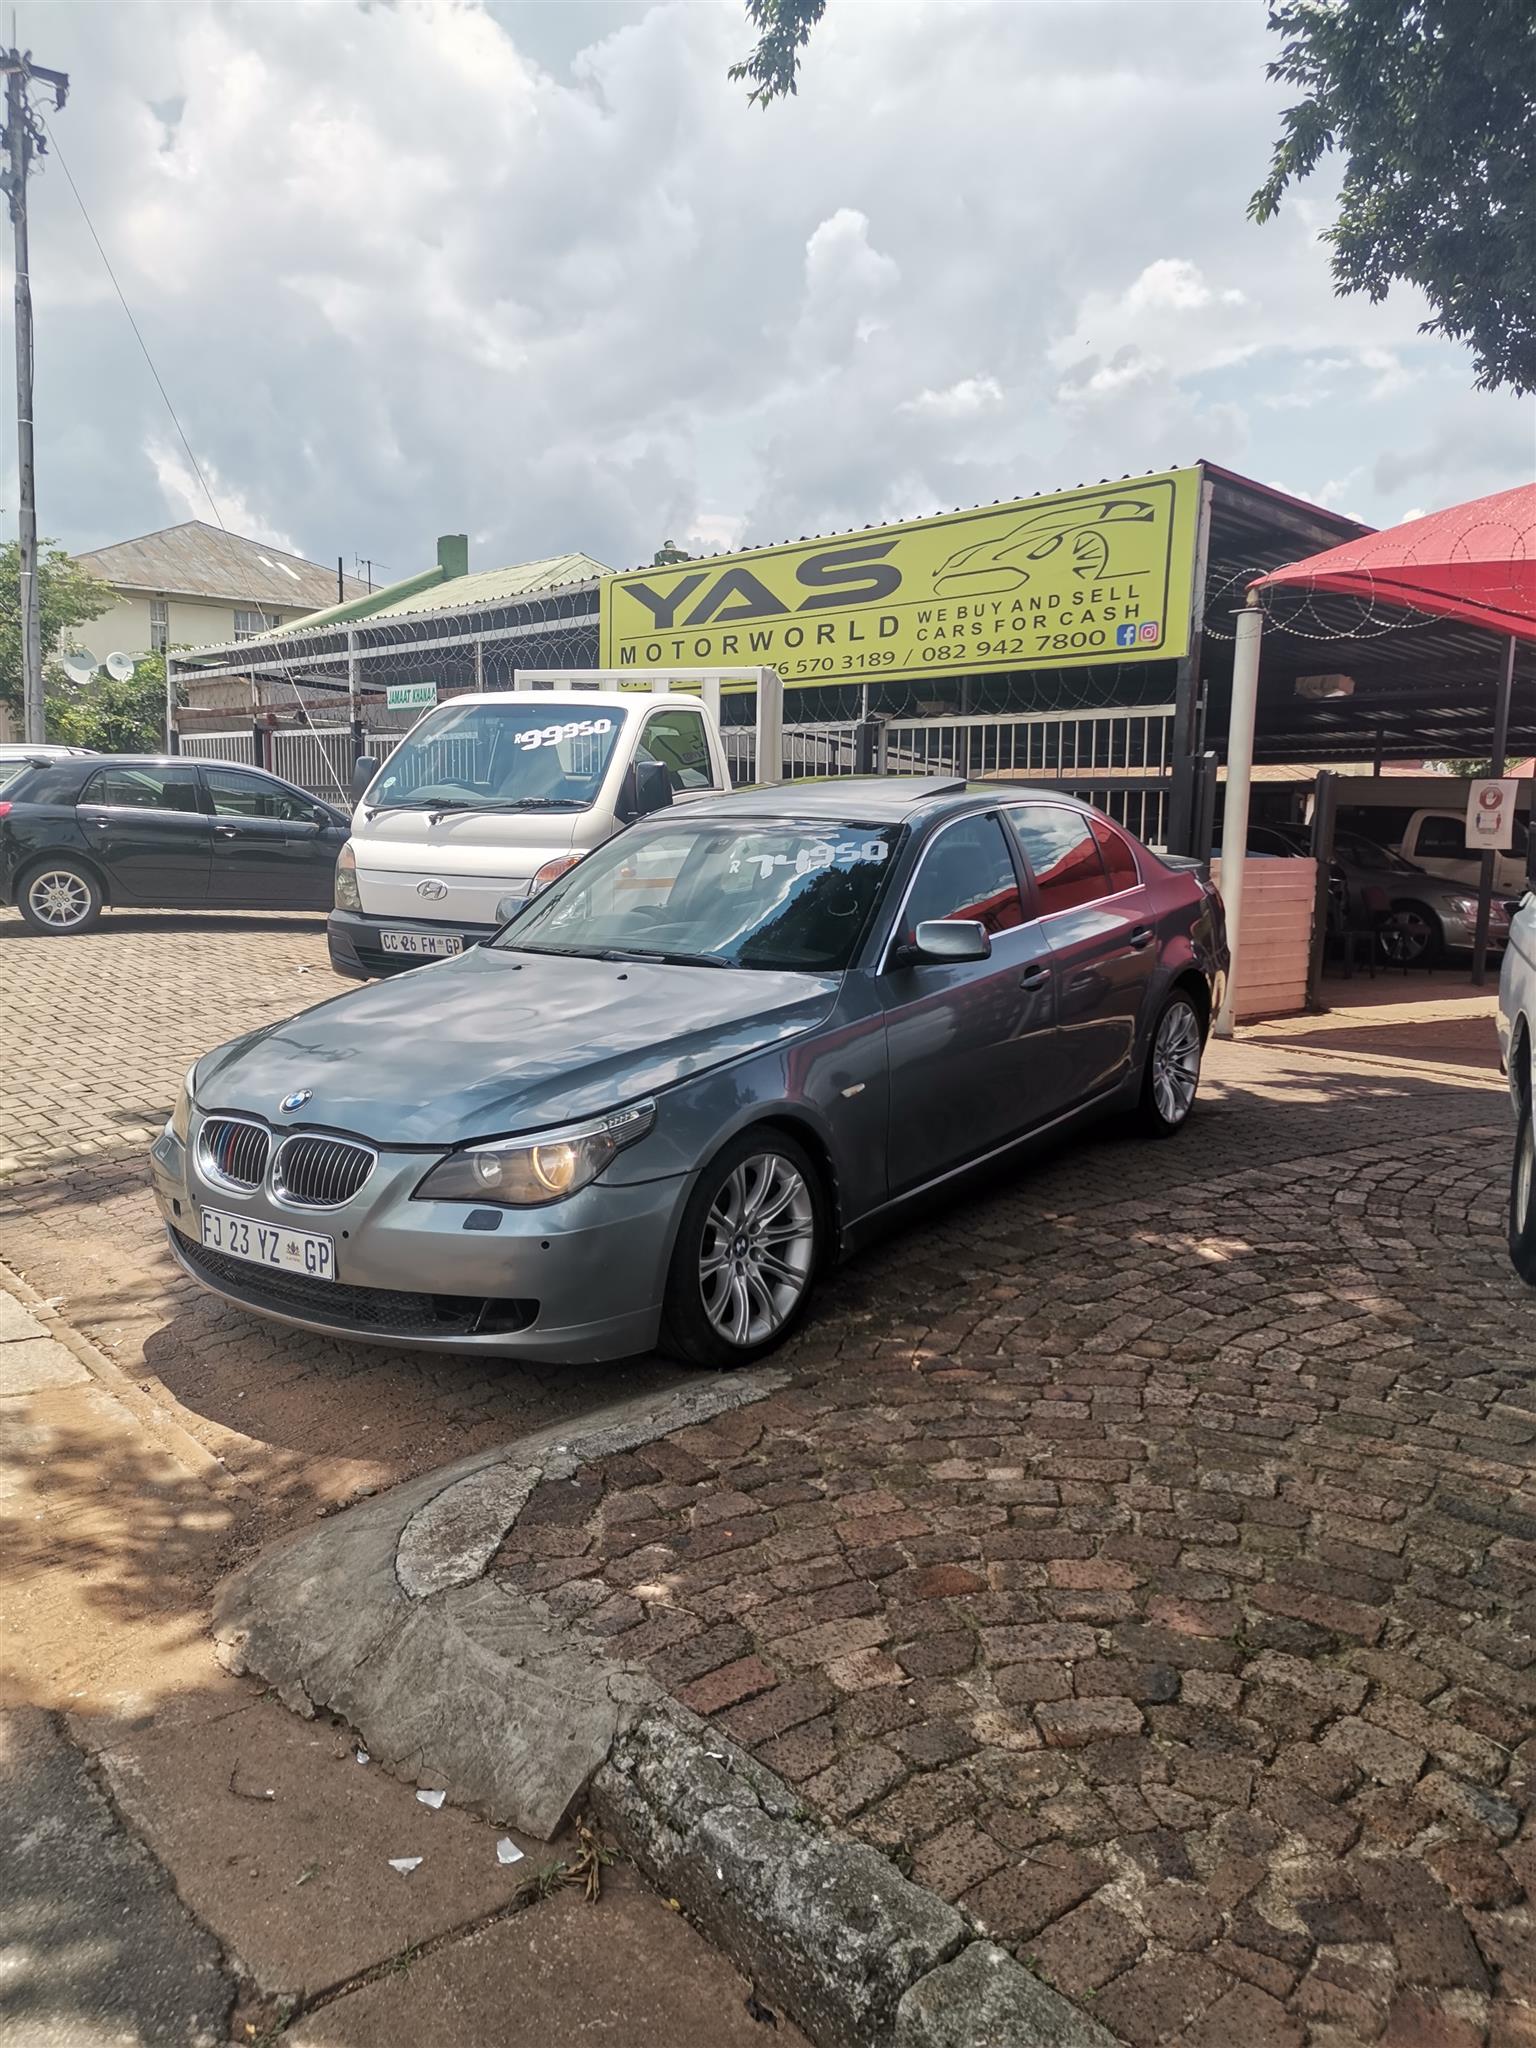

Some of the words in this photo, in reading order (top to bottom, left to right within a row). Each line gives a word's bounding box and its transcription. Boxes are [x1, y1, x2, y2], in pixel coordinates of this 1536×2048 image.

[620, 540, 903, 629] YAS
[917, 609, 947, 624] WE
[957, 601, 1002, 619] BUY
[1011, 595, 1061, 613] AND
[1072, 584, 1140, 605] SELL
[620, 615, 899, 665] MOTORWORLD
[916, 622, 982, 641] CARS
[994, 615, 1047, 633] FOR
[1059, 603, 1140, 626] CASH
[796, 657, 834, 674] 570
[841, 651, 895, 669] 3189
[922, 644, 966, 661] 082
[976, 638, 1024, 657] 942
[1034, 629, 1106, 651] 7800
[383, 934, 398, 950] CC
[445, 938, 460, 955] GP
[203, 1213, 221, 1247] FJ
[230, 1221, 249, 1255] 23
[258, 1228, 280, 1264] YZ
[304, 1239, 330, 1274] GP
